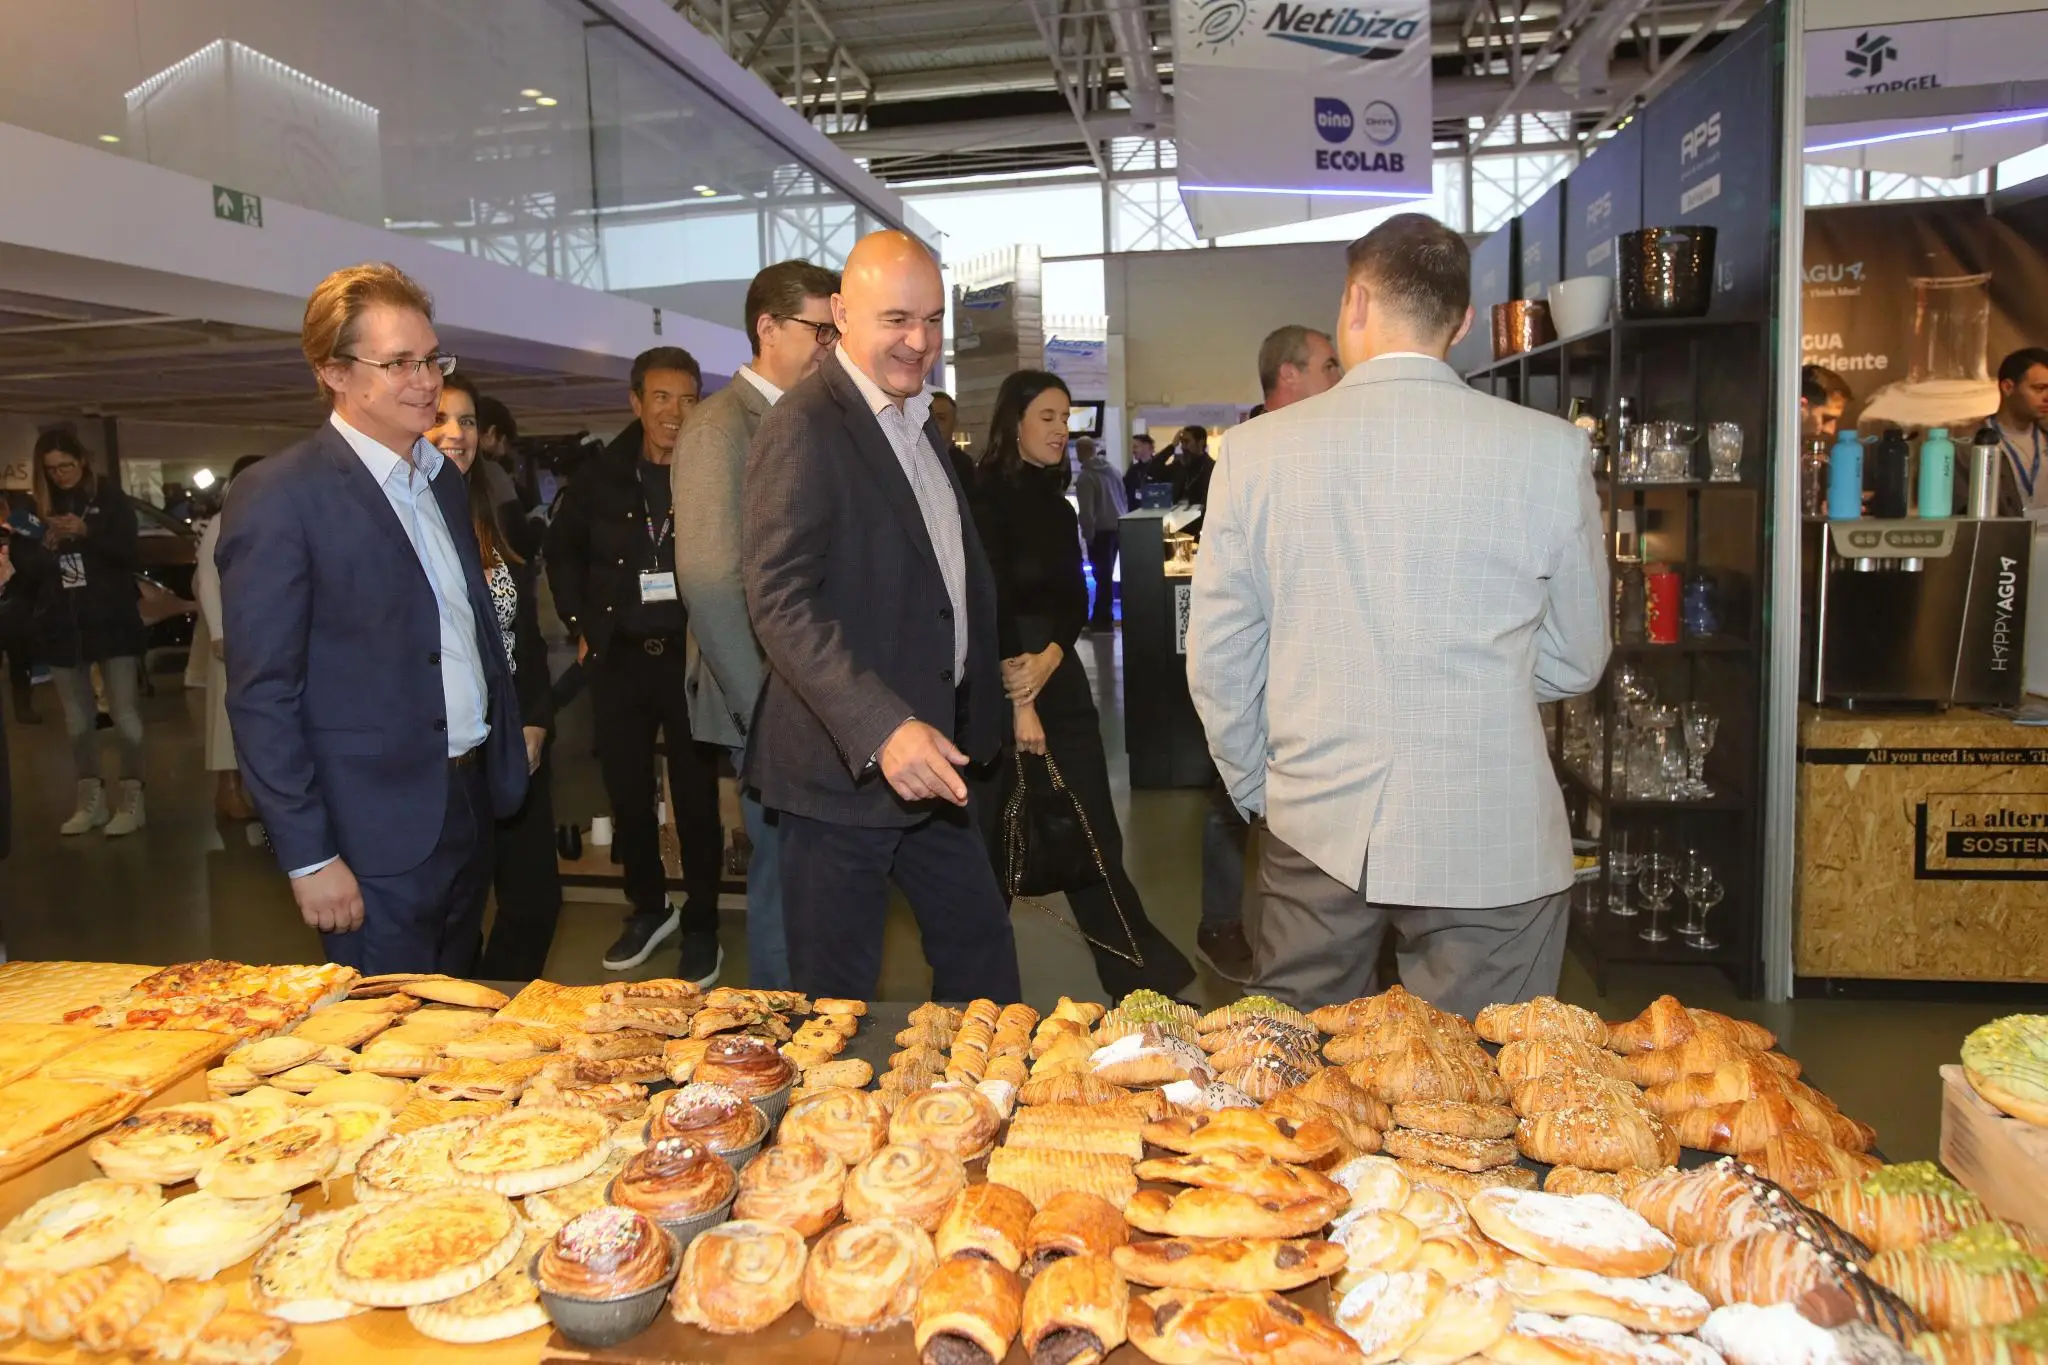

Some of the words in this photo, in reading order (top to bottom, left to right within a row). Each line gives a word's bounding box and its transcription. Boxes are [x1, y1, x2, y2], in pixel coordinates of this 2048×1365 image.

[1263, 2, 1419, 40] Netibiza
[1865, 74, 1942, 95] TOPGEL
[1681, 111, 1721, 165] APS
[1315, 149, 1404, 173] ECOLAB
[0, 463, 28, 480] AS
[1866, 750, 1887, 762] All
[1891, 752, 1918, 764] you
[1921, 750, 1958, 762] need
[1962, 750, 1975, 762] is
[1978, 751, 2027, 763] water.
[1950, 808, 1977, 827] La
